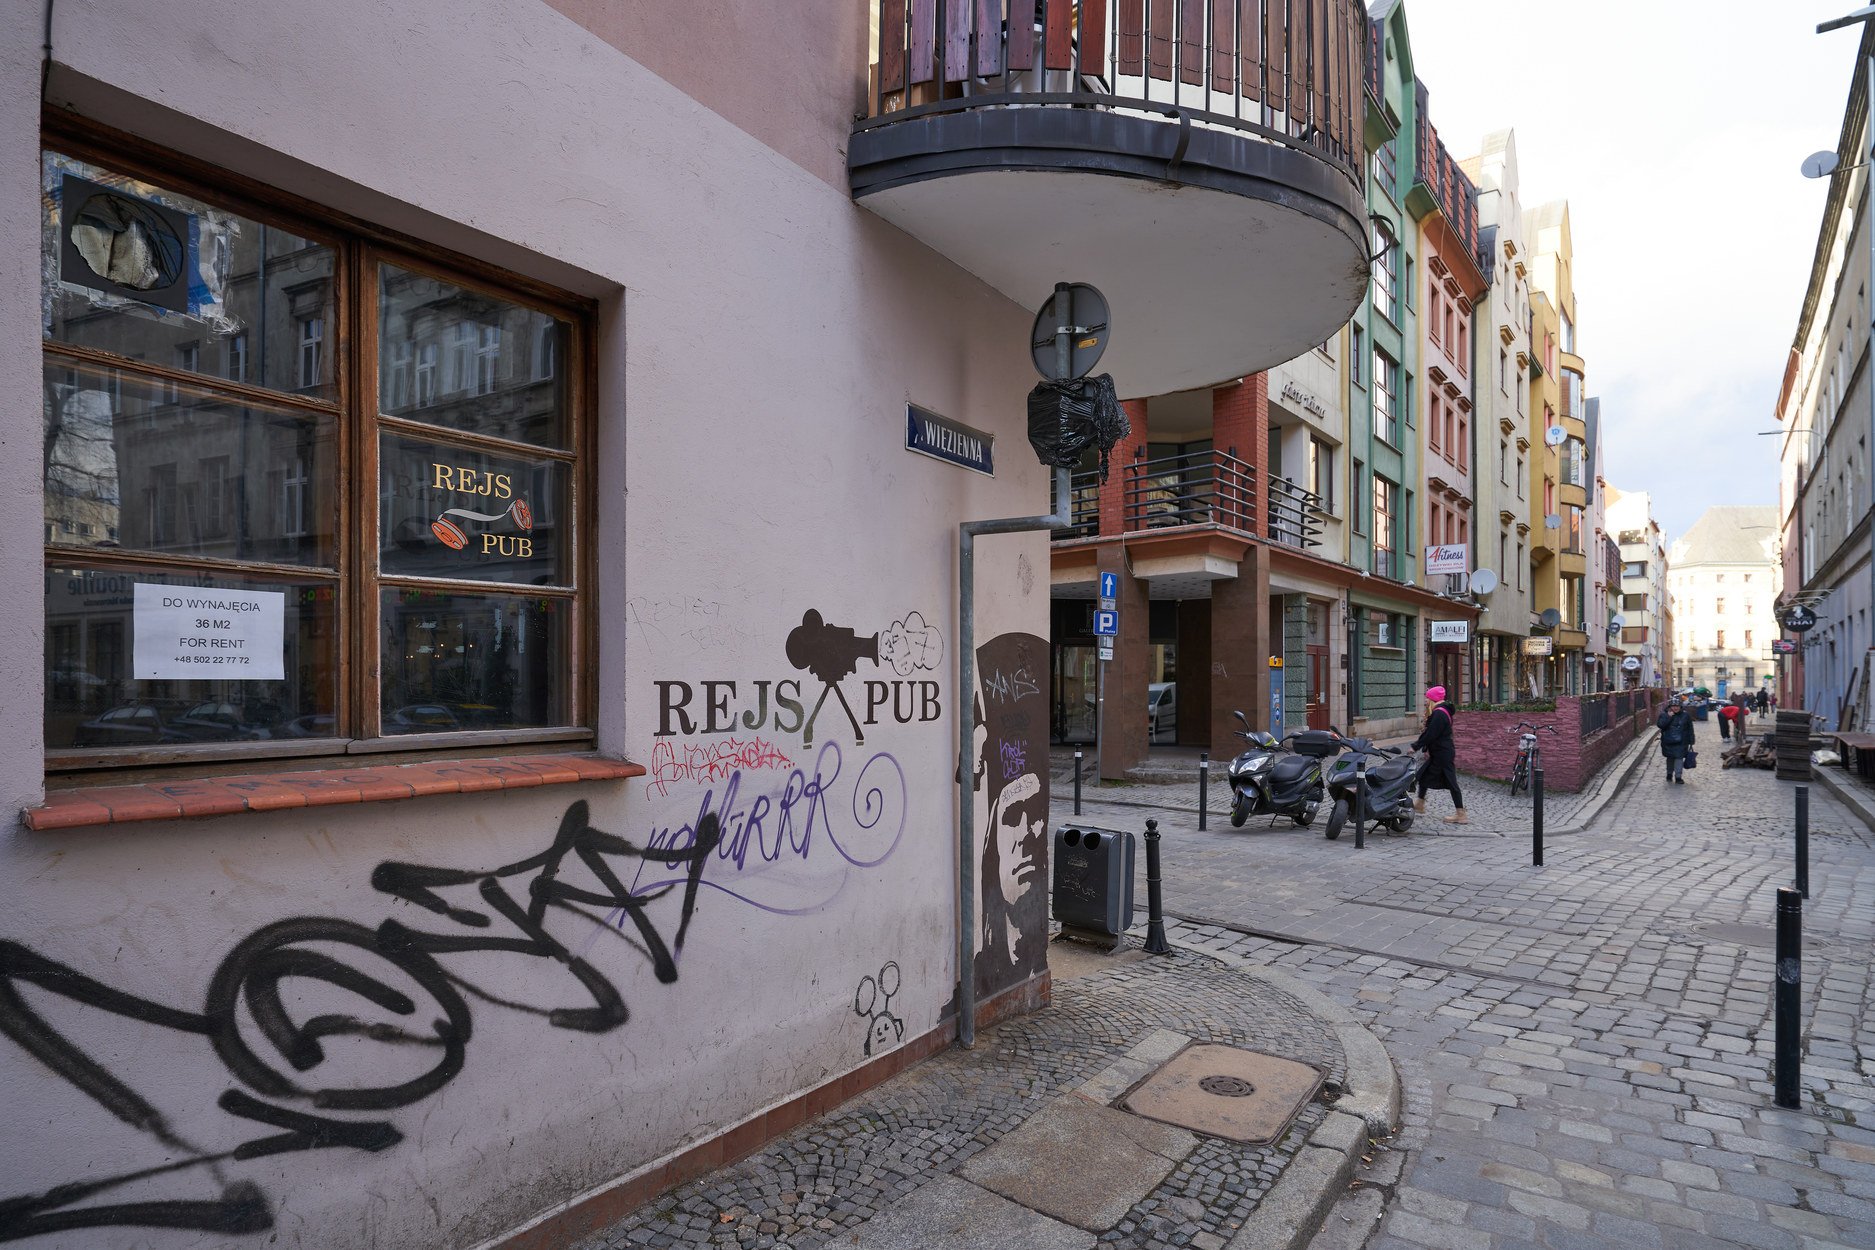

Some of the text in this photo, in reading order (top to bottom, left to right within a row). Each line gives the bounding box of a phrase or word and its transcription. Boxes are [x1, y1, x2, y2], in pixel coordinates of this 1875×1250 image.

[925, 420, 982, 463] WIĘZIENNA
[432, 463, 512, 499] REJS
[481, 533, 533, 558] PUB
[163, 597, 261, 613] DO WYNAJĘCIA
[195, 619, 231, 629] 36 M2
[1100, 613, 1113, 632] P
[179, 637, 245, 649] FOR RENT
[174, 655, 250, 664] +48 502 22 77 72
[653, 679, 942, 737] REJS PUB
